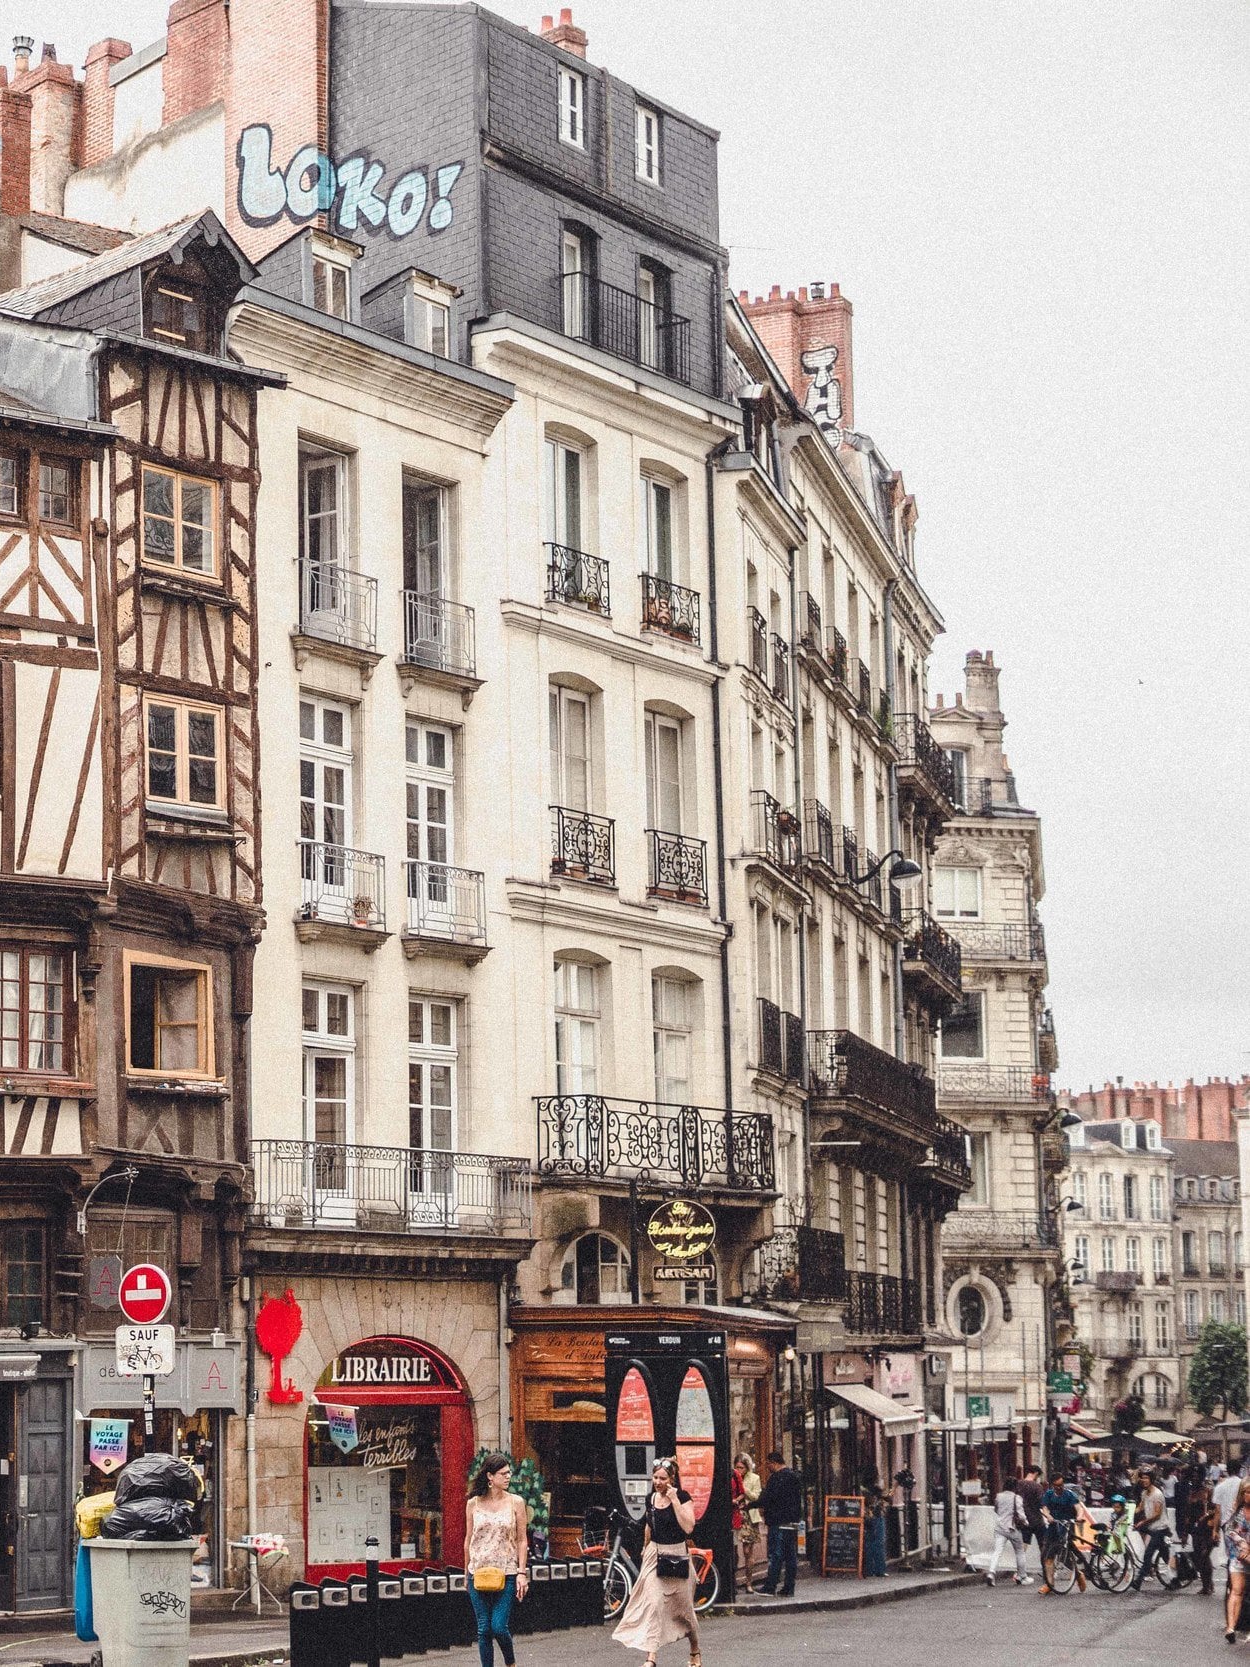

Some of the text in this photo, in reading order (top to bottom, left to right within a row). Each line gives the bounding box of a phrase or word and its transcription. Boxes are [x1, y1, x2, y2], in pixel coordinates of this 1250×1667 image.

[655, 1268, 710, 1278] ARTISAN
[130, 1329, 159, 1341] SAUF
[658, 1336, 681, 1345] VERDUN
[331, 1357, 431, 1382] LIBRAIRIE
[376, 1416, 416, 1448] enfants
[357, 1439, 417, 1468] terribles
